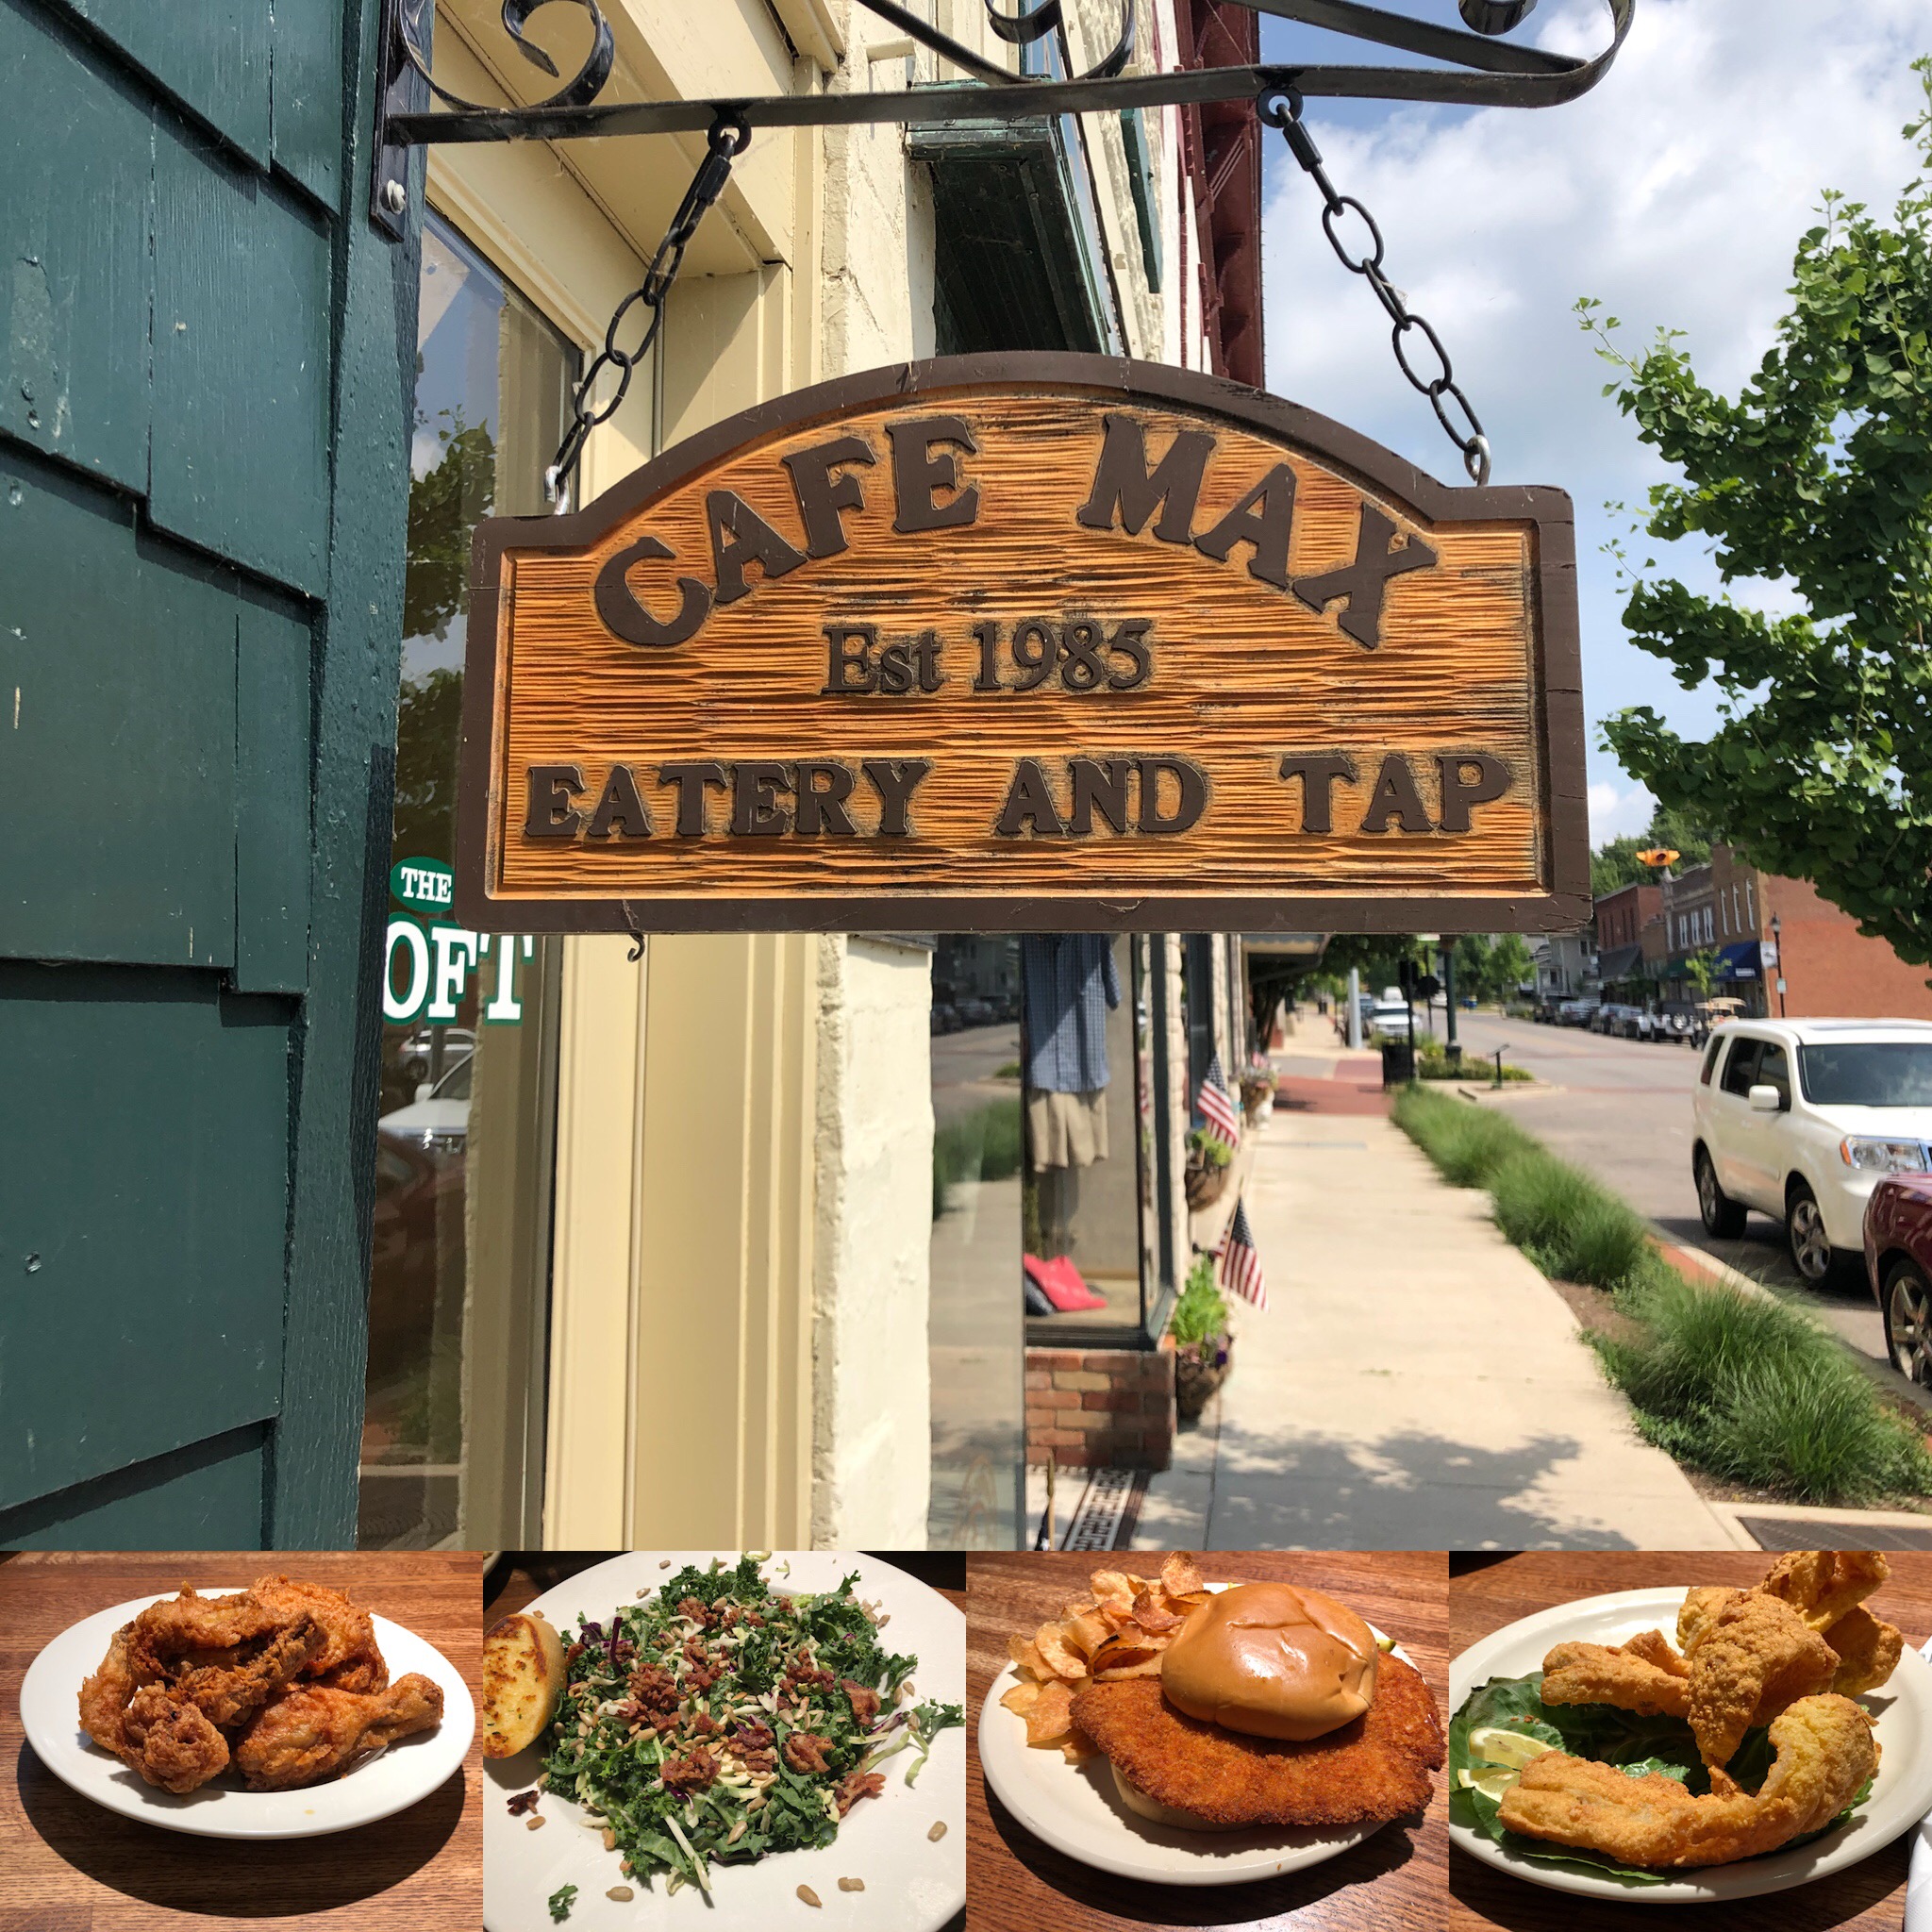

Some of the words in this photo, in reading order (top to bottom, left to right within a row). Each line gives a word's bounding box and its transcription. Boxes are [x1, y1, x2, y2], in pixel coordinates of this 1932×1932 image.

[594, 416, 981, 646] CAFE
[1077, 413, 1439, 650] MAX
[822, 624, 943, 694] Est
[973, 618, 1154, 692] 1985
[525, 761, 929, 838] EATERY
[996, 758, 1208, 834] AND
[1280, 755, 1511, 832] TAP
[401, 867, 452, 903] THE
